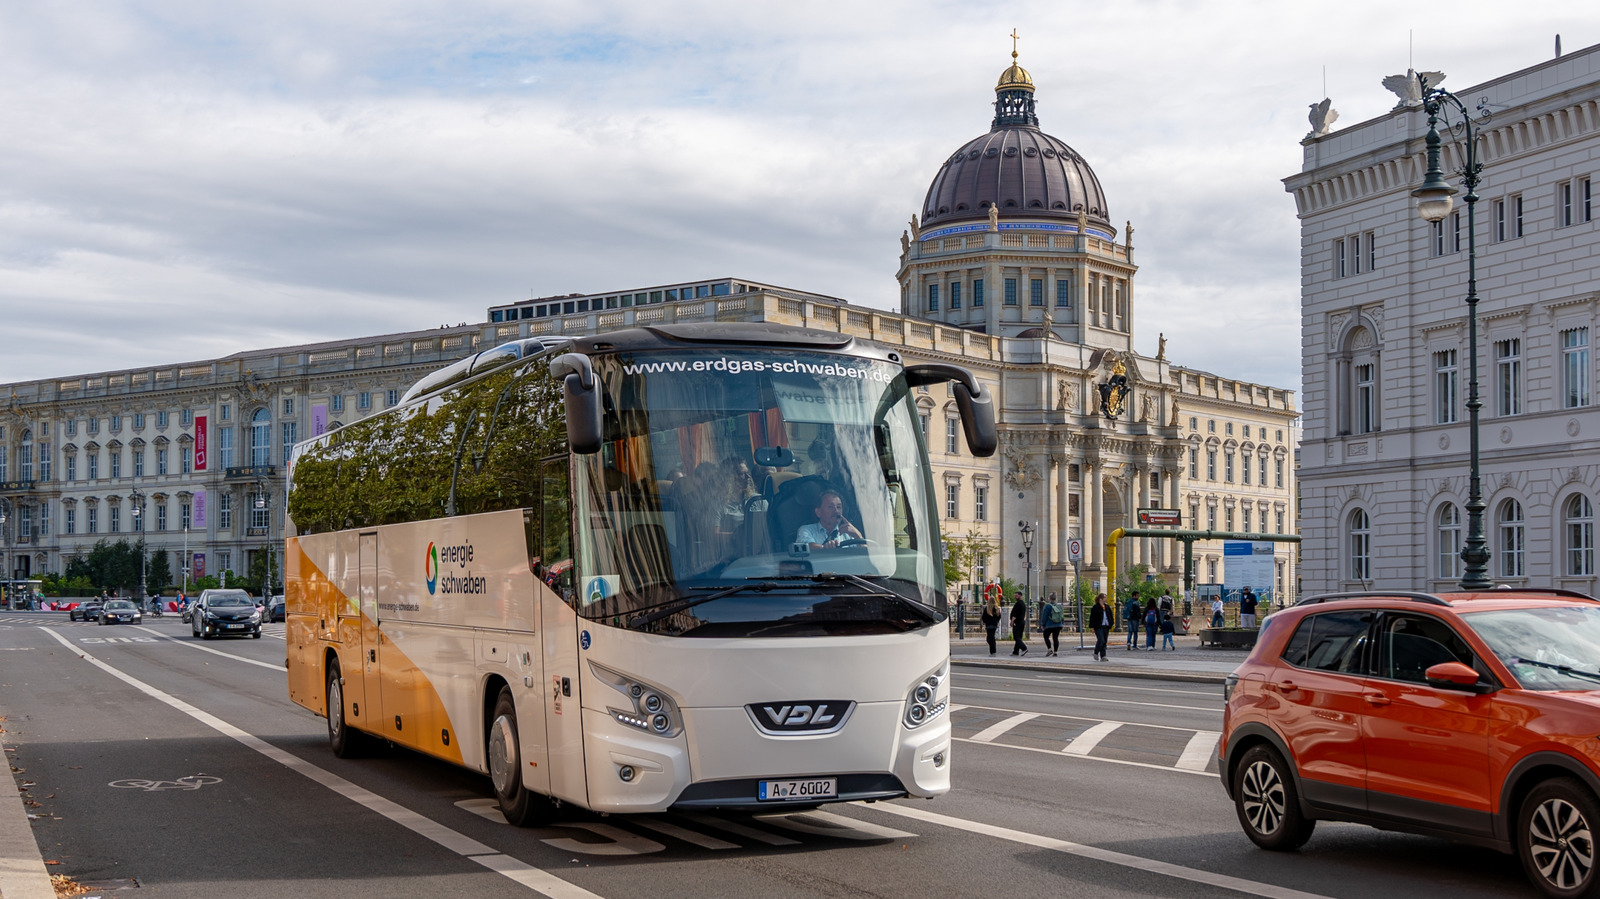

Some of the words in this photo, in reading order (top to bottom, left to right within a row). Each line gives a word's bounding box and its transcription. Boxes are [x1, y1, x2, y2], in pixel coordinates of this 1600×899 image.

[623, 357, 891, 384] www.erdgas-schwaben.de
[441, 539, 474, 568] energie
[441, 570, 487, 594] schwaben
[379, 602, 419, 613] www.energie-schwaben.de
[763, 704, 835, 726] VDL
[772, 783, 781, 797] A
[789, 783, 797, 796] Z
[800, 781, 831, 795] 6002
